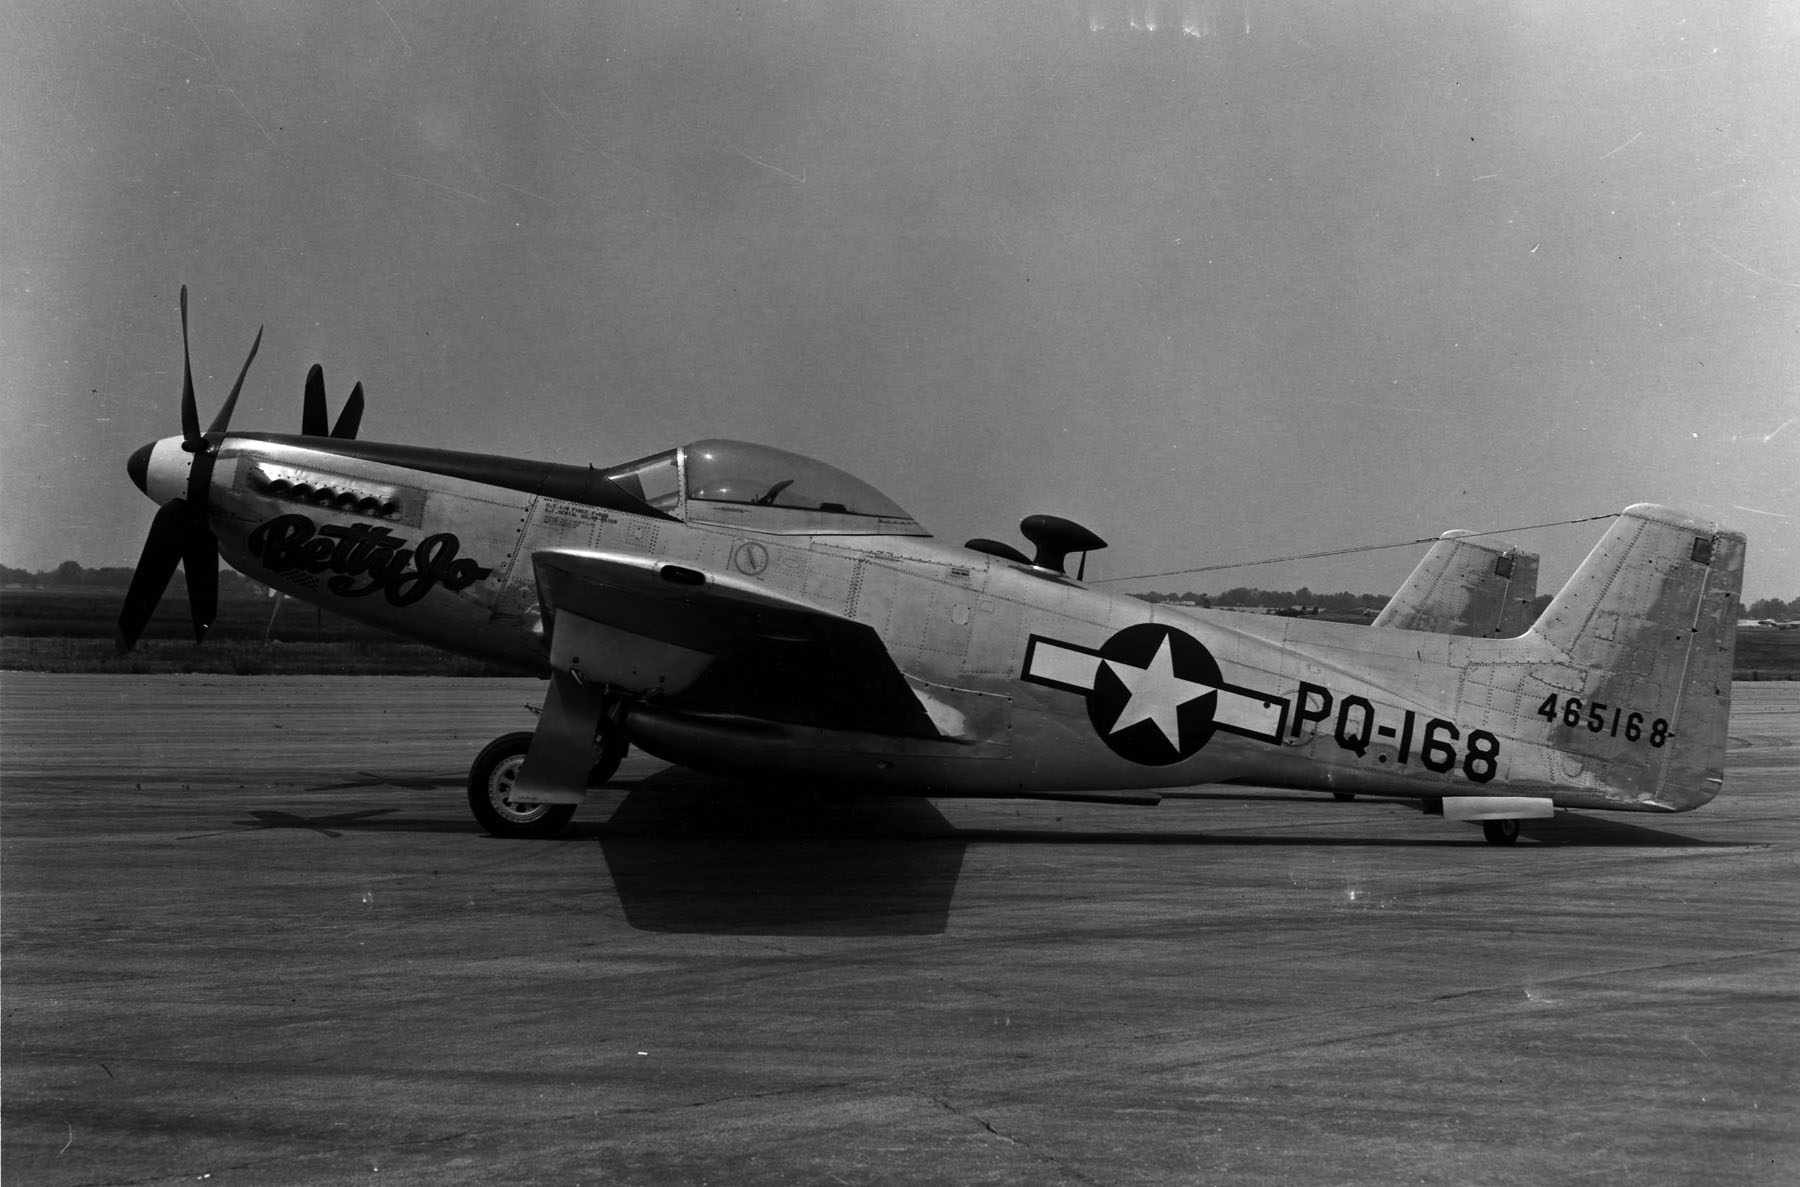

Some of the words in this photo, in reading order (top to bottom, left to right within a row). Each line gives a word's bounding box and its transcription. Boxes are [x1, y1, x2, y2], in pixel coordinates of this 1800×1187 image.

[248, 513, 415, 598] Betty
[384, 532, 494, 607] Jo
[1290, 680, 1501, 784] PQ-168
[1537, 692, 1671, 749] 465168
